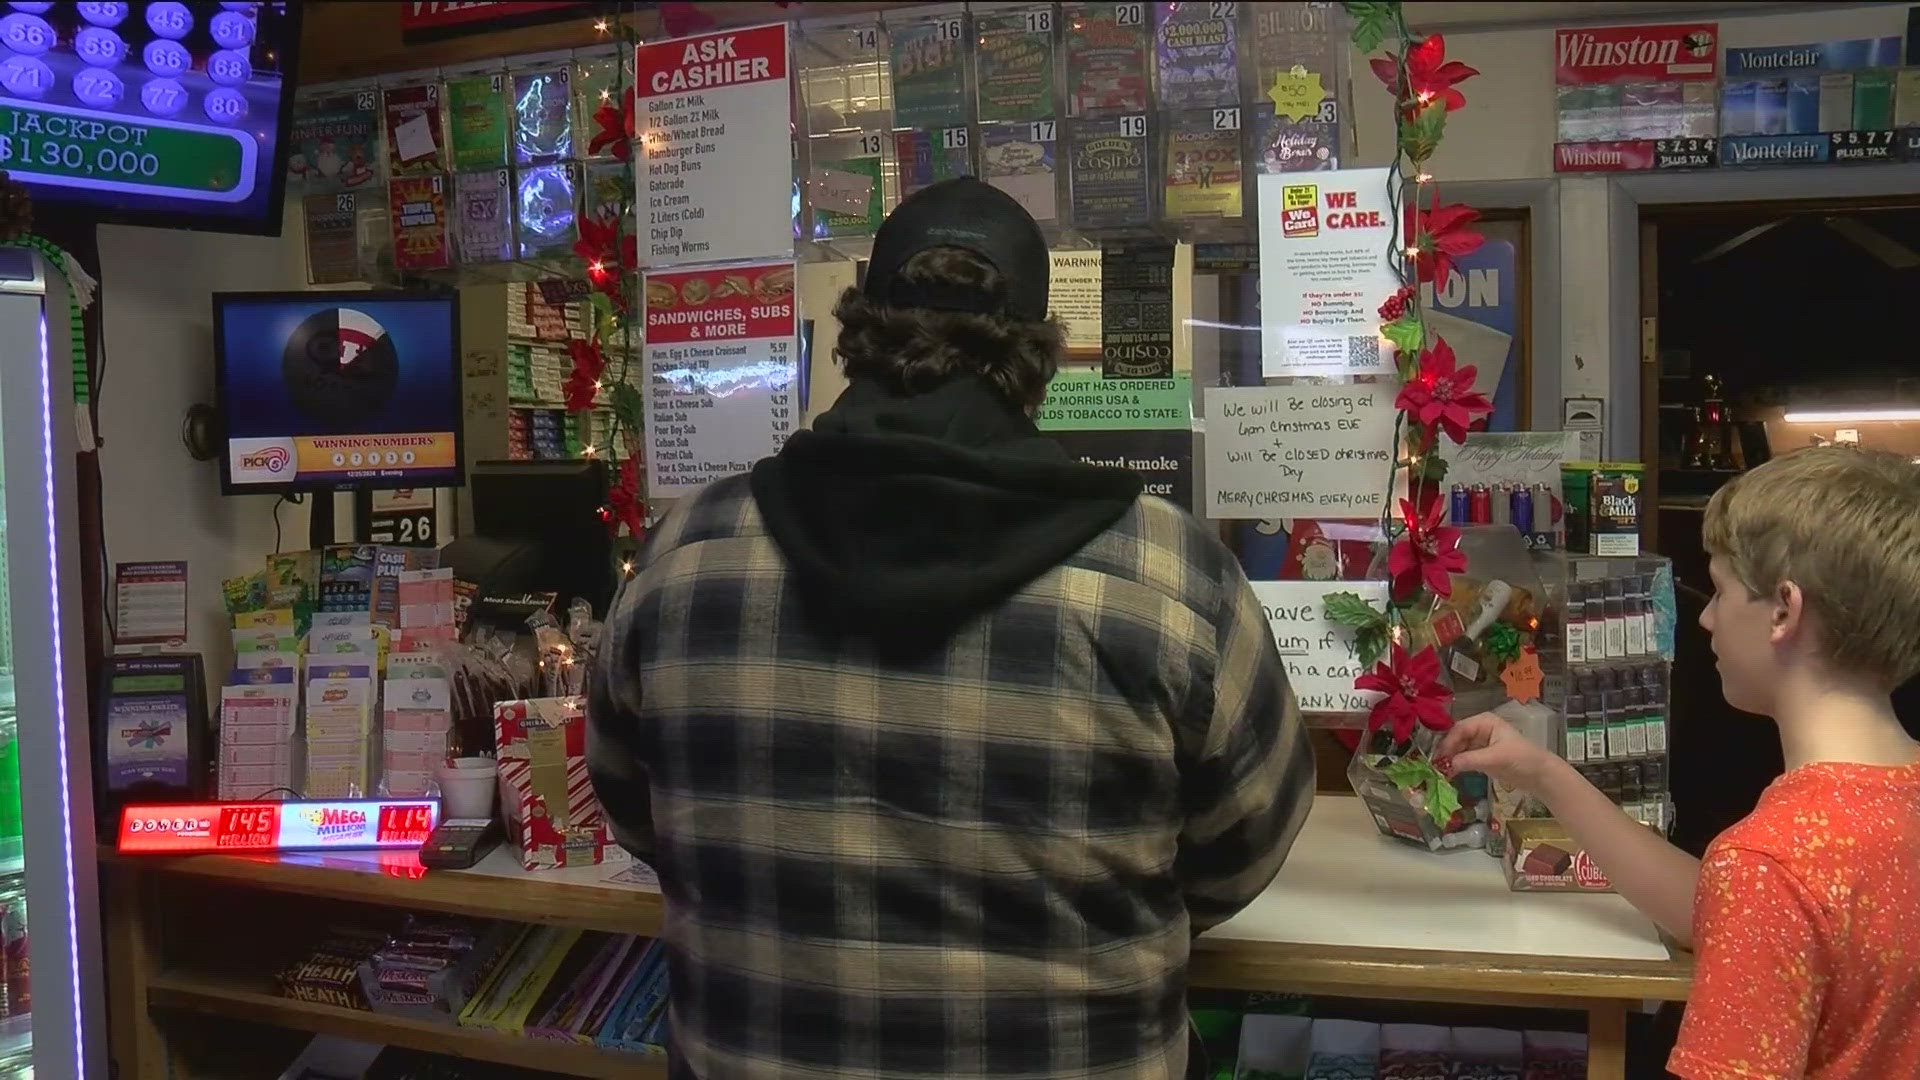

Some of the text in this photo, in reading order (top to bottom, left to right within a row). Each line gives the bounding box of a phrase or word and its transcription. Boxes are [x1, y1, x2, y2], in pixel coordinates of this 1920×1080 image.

[1118, 6, 1140, 23] 20
[1212, 1, 1235, 18] 22
[153, 11, 244, 40] 45 51
[1028, 13, 1050, 31] 18
[939, 22, 960, 39] 16
[857, 31, 876, 48] 14
[1167, 33, 1226, 47] CASH BLAST
[9, 24, 242, 78] 56 59 66 68
[681, 36, 737, 66] ASK
[1558, 33, 1679, 67] Winston
[1740, 50, 1820, 68] Montclair
[560, 69, 568, 82] 6
[652, 56, 770, 93] CASHIER
[7, 65, 239, 115] 71 72 77 80
[428, 86, 437, 98] 2
[493, 77, 500, 91] 4
[359, 92, 374, 110] 25
[649, 95, 704, 112] Gallon 2% Milk
[650, 110, 720, 128] 1/2 Gallon 2% Milk
[1122, 118, 1145, 135] 19
[1215, 111, 1238, 128] 21
[10, 111, 148, 146] JACKPOT
[649, 124, 725, 144] White/Wheat Bread
[1033, 122, 1054, 140] 17
[860, 136, 880, 154] 13
[945, 129, 967, 147] 15
[1087, 140, 1129, 151] GOLDEN
[1272, 134, 1317, 148] Holiday
[0, 134, 159, 176] $130,000
[649, 142, 716, 161] Hamburger Buns
[1561, 149, 1621, 166] Winston
[1731, 141, 1819, 160] Montclair
[1836, 147, 1887, 158] PLUS TAX
[649, 160, 702, 176] Hot Dog Buns
[1661, 155, 1709, 166] PLUS TAX
[500, 171, 507, 187] 3
[566, 165, 574, 179] 5
[434, 179, 440, 192] 1
[649, 177, 684, 192] Gatorade
[339, 195, 353, 210] 26
[650, 194, 690, 208] Ice Cream
[1325, 192, 1357, 209] WE
[650, 208, 704, 224] 2 Liters (Cold)
[1288, 210, 1311, 221] We
[1326, 211, 1386, 229] CARE.
[1285, 217, 1316, 231] Card
[651, 226, 683, 242] Chip Dip
[651, 241, 710, 257] Fishing Worms
[649, 305, 791, 326] SANDWICHES, SUBS
[690, 323, 747, 338] & MORE
[670, 345, 747, 360] Egg Cheese Croissant
[1051, 381, 1175, 392] COURT HAS ORDERED
[653, 398, 713, 409] Ham Cheese Sub
[1060, 395, 1140, 406] MORRIS USA &
[1223, 394, 1373, 417] We will Be closing at
[675, 412, 688, 422] Sub
[1067, 409, 1182, 420] TOBACCO TO STATE:
[671, 425, 682, 436] Boy
[684, 425, 696, 434] Sub
[1338, 419, 1361, 430] EVE
[314, 438, 434, 448] WINNING NUMBERS
[676, 438, 689, 447] Sub
[243, 457, 269, 467] PICK
[656, 450, 693, 460] Pretzel Club
[1227, 451, 1251, 463] Will
[1259, 449, 1276, 462] Be
[1457, 446, 1563, 472] Happy Holidays
[678, 462, 697, 472] Share
[704, 462, 727, 472] Cheese
[729, 461, 746, 471] Pizza
[1128, 456, 1178, 471] smoke
[1256, 491, 1314, 505] CHRISTMAS
[1602, 495, 1635, 506] Black
[1609, 504, 1636, 516] Mild
[400, 516, 430, 542] 26
[380, 553, 406, 563] CASH
[1307, 666, 1320, 677] a
[1339, 693, 1371, 709] YOU
[230, 811, 270, 832] 145
[322, 808, 366, 825] MEGA
[131, 818, 198, 832] POWER
[220, 831, 430, 846] MILLION BILLION
[298, 963, 357, 984] HEATH
[295, 985, 350, 1008] HEATH
